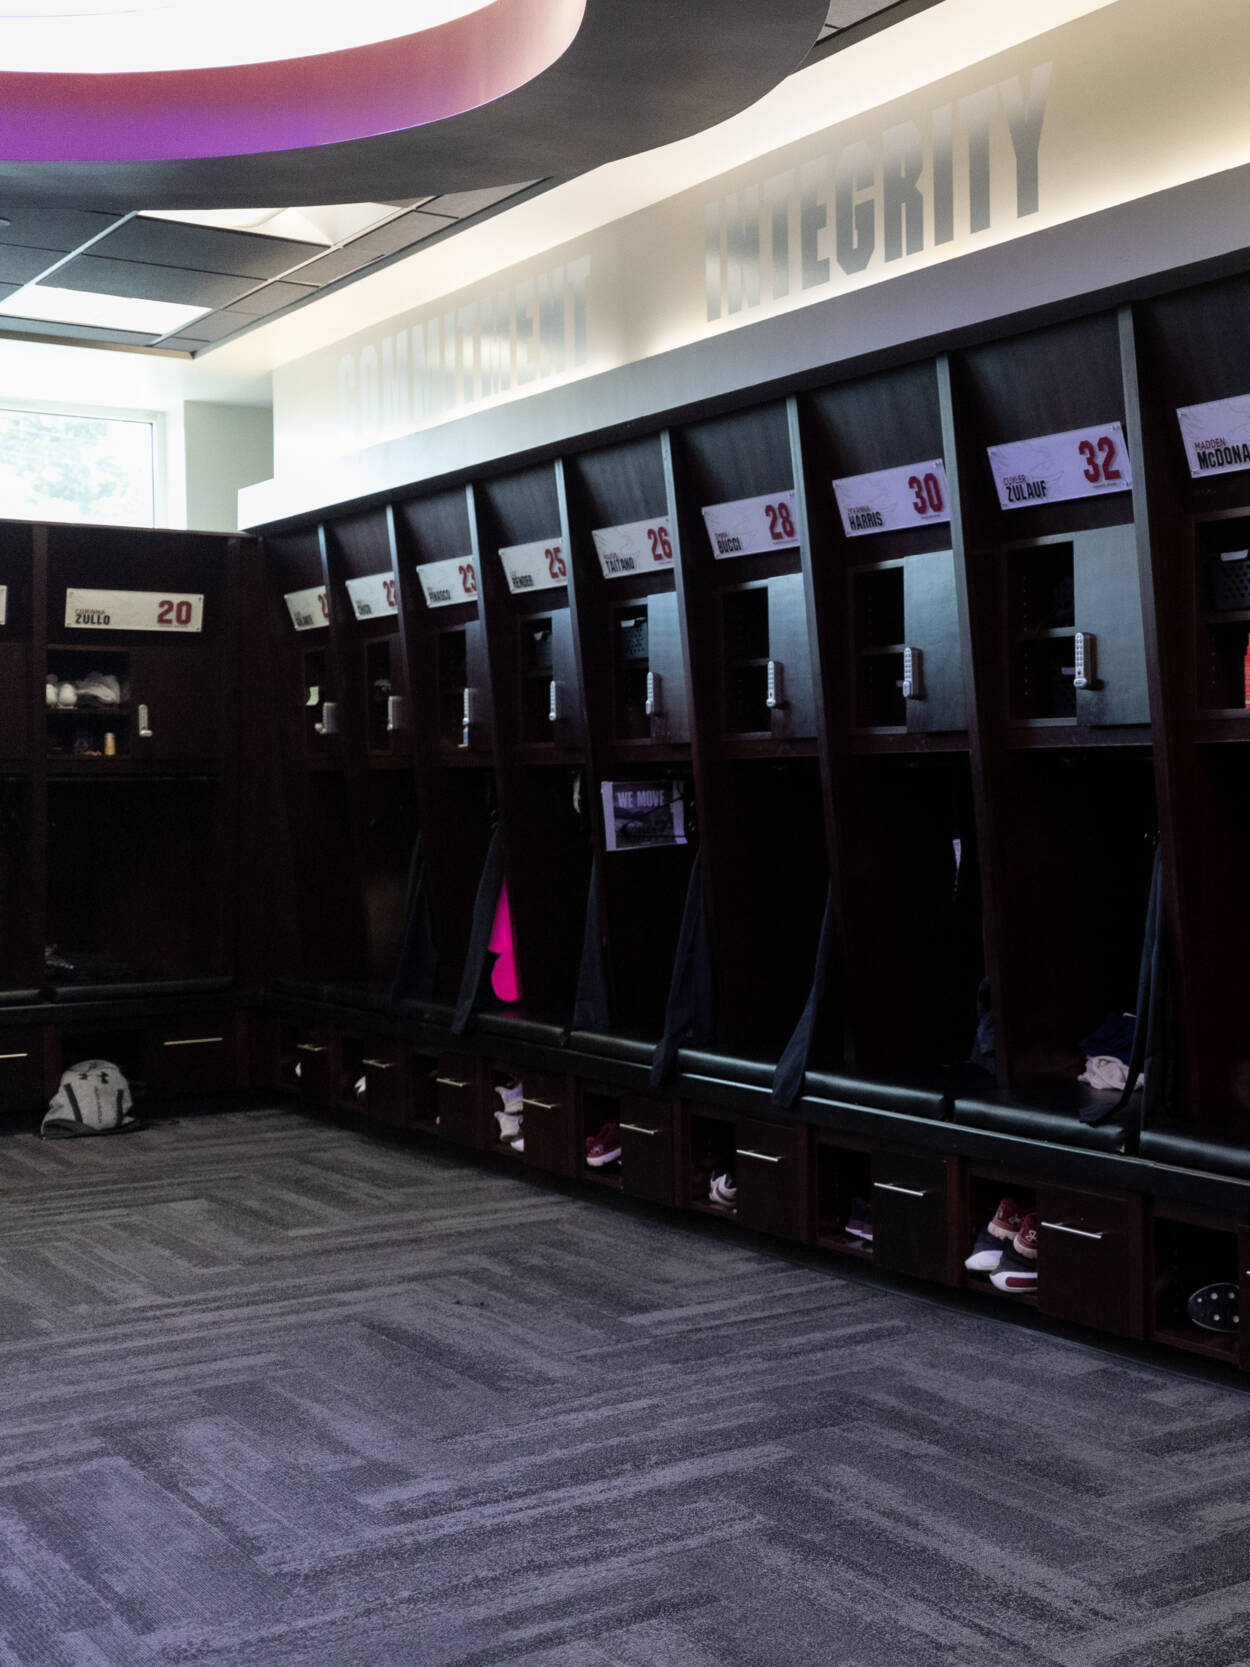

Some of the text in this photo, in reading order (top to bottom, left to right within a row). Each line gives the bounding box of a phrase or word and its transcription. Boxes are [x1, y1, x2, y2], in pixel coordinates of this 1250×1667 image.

[704, 61, 1053, 322] INTEGRITY
[337, 255, 592, 440] COMMITMENT
[1194, 437, 1227, 450] MADDEN
[1078, 436, 1121, 483] 32
[908, 472, 944, 515] 30
[1006, 480, 1047, 503] ZULAUF
[765, 502, 795, 540] 28
[848, 511, 884, 531] HARRIS
[647, 526, 673, 560] 26
[717, 536, 742, 554] BUCCI
[545, 546, 567, 579] 25
[458, 564, 477, 593] 23
[75, 614, 110, 626] ZULLO
[157, 600, 192, 626] 20
[616, 790, 665, 809] WE MOVE
